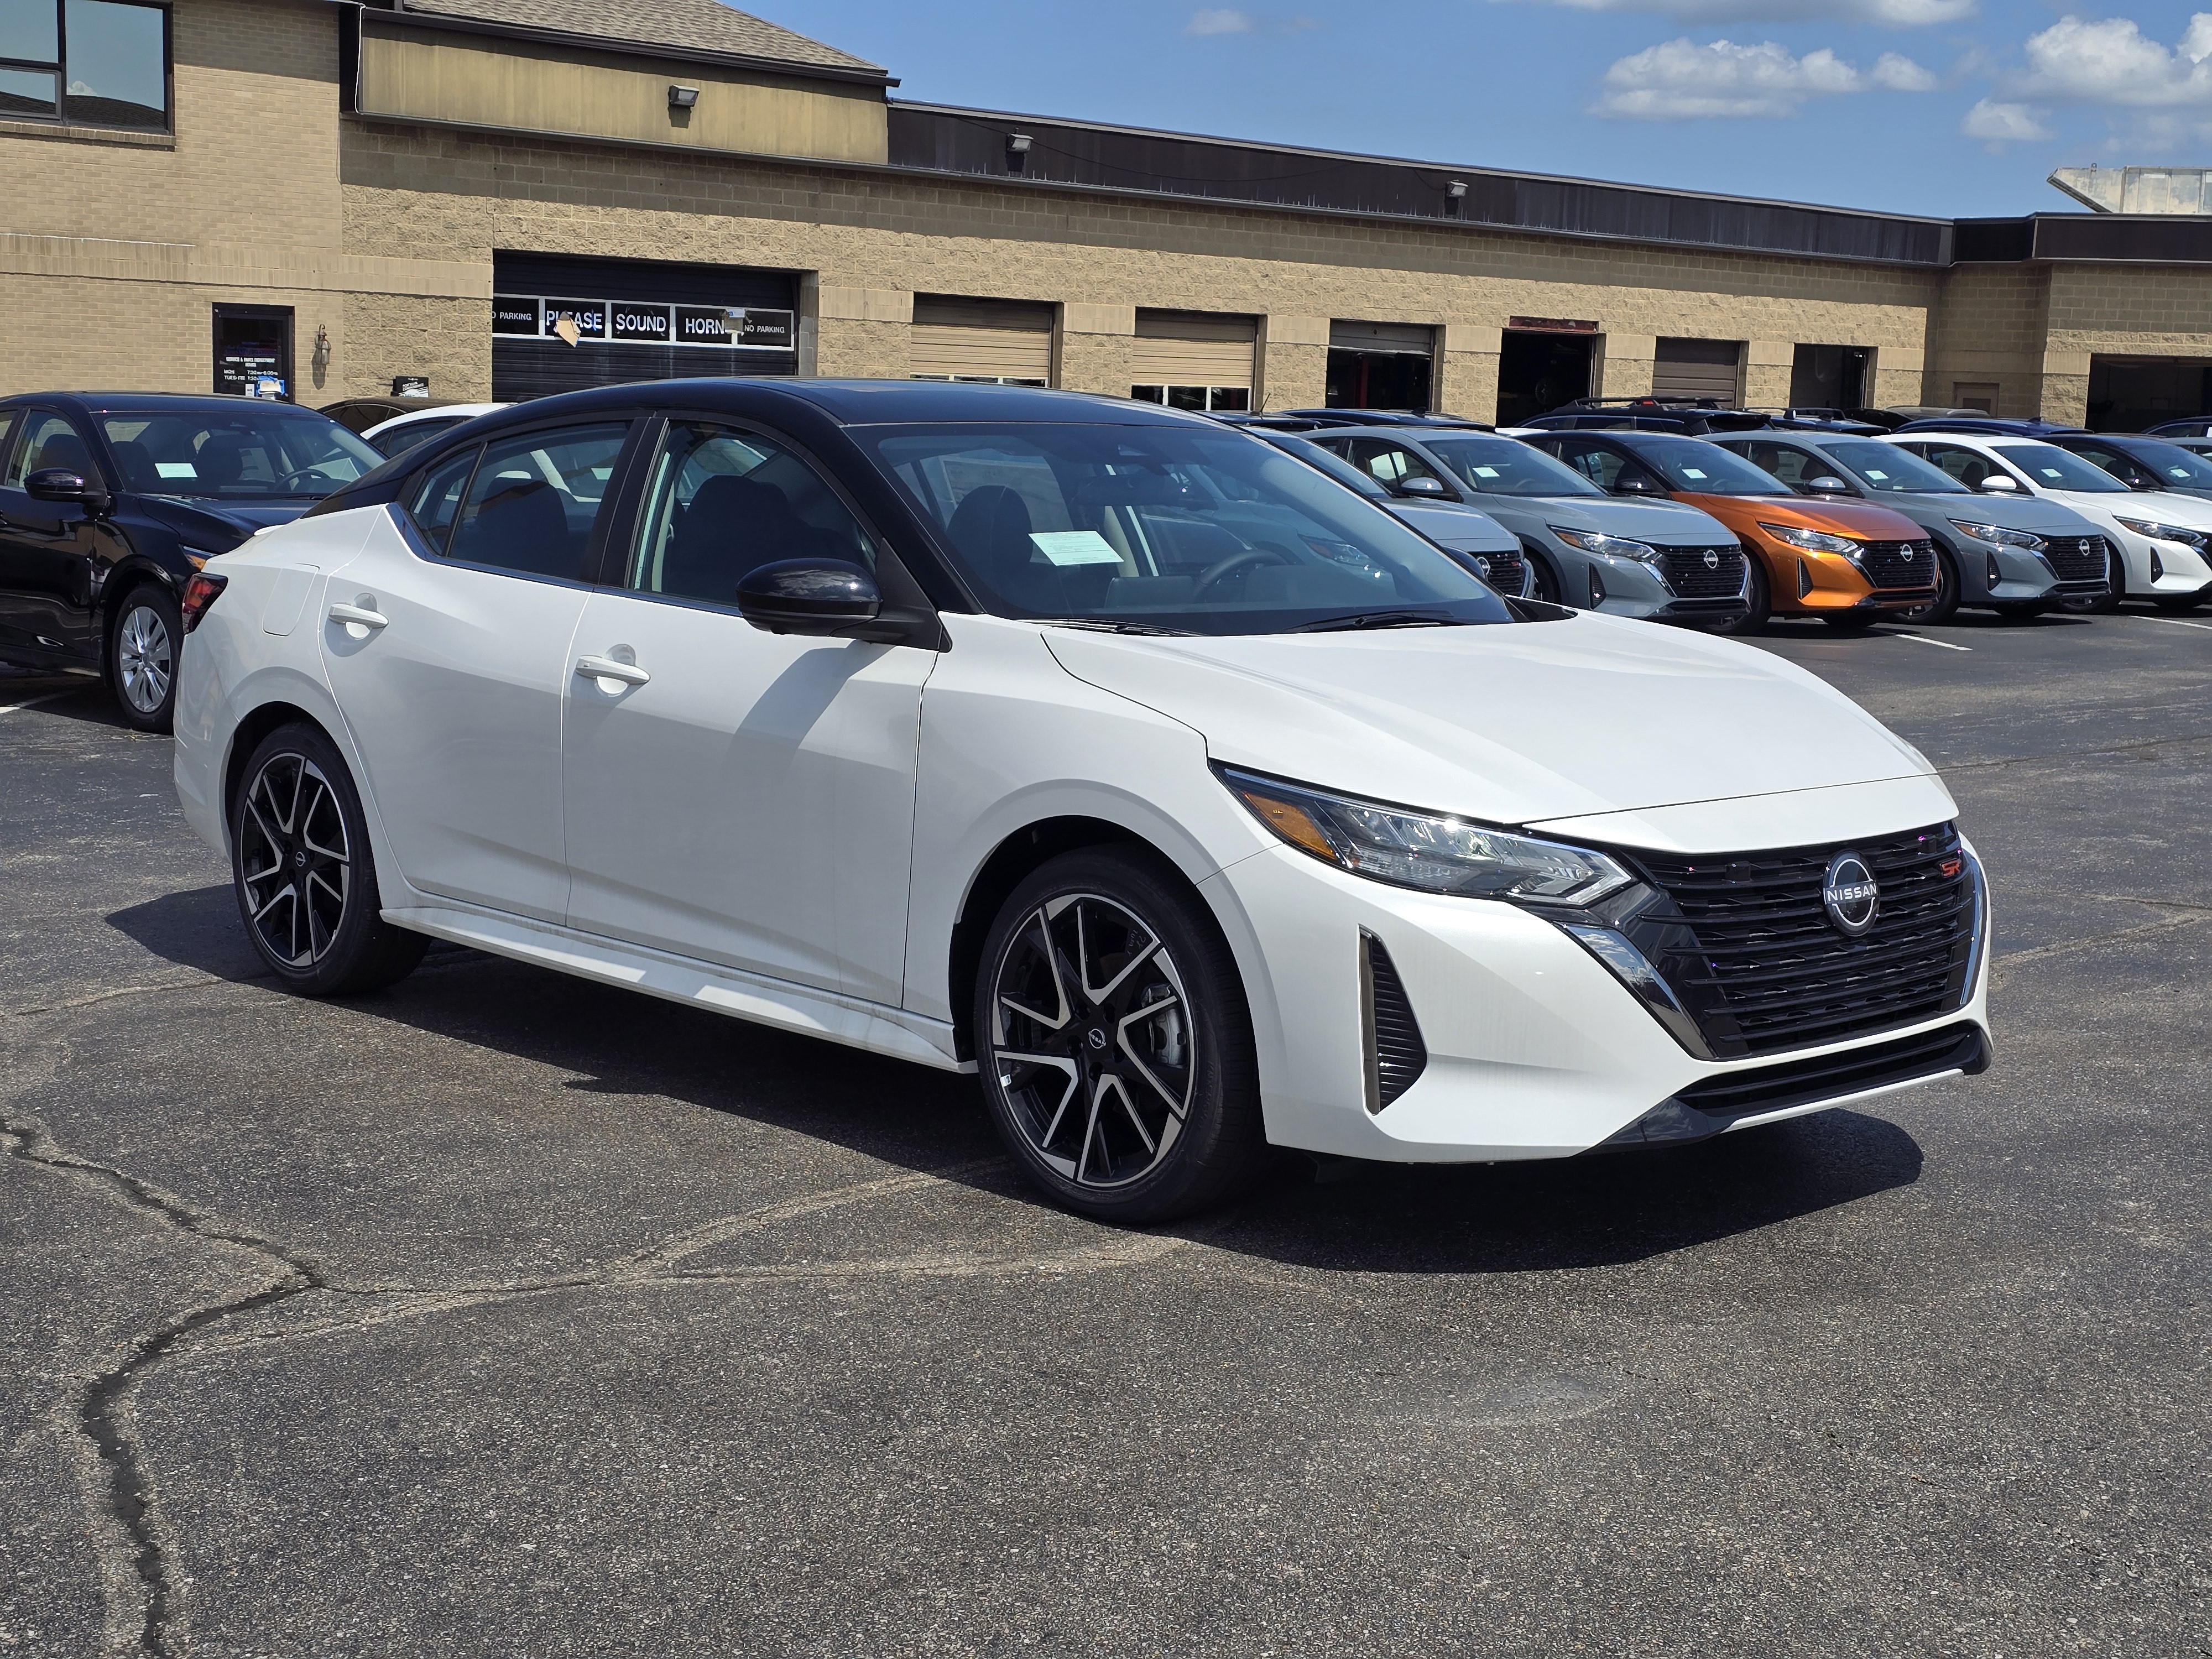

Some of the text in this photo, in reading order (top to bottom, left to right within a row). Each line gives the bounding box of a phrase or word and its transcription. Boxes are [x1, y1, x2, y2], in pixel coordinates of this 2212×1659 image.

[499, 312, 532, 321] PARKING
[615, 313, 666, 332] SOUND
[685, 317, 725, 335] HORN
[757, 325, 785, 333] PARKING
[1941, 859, 1962, 877] SR
[1827, 883, 1877, 902] NISSAN
